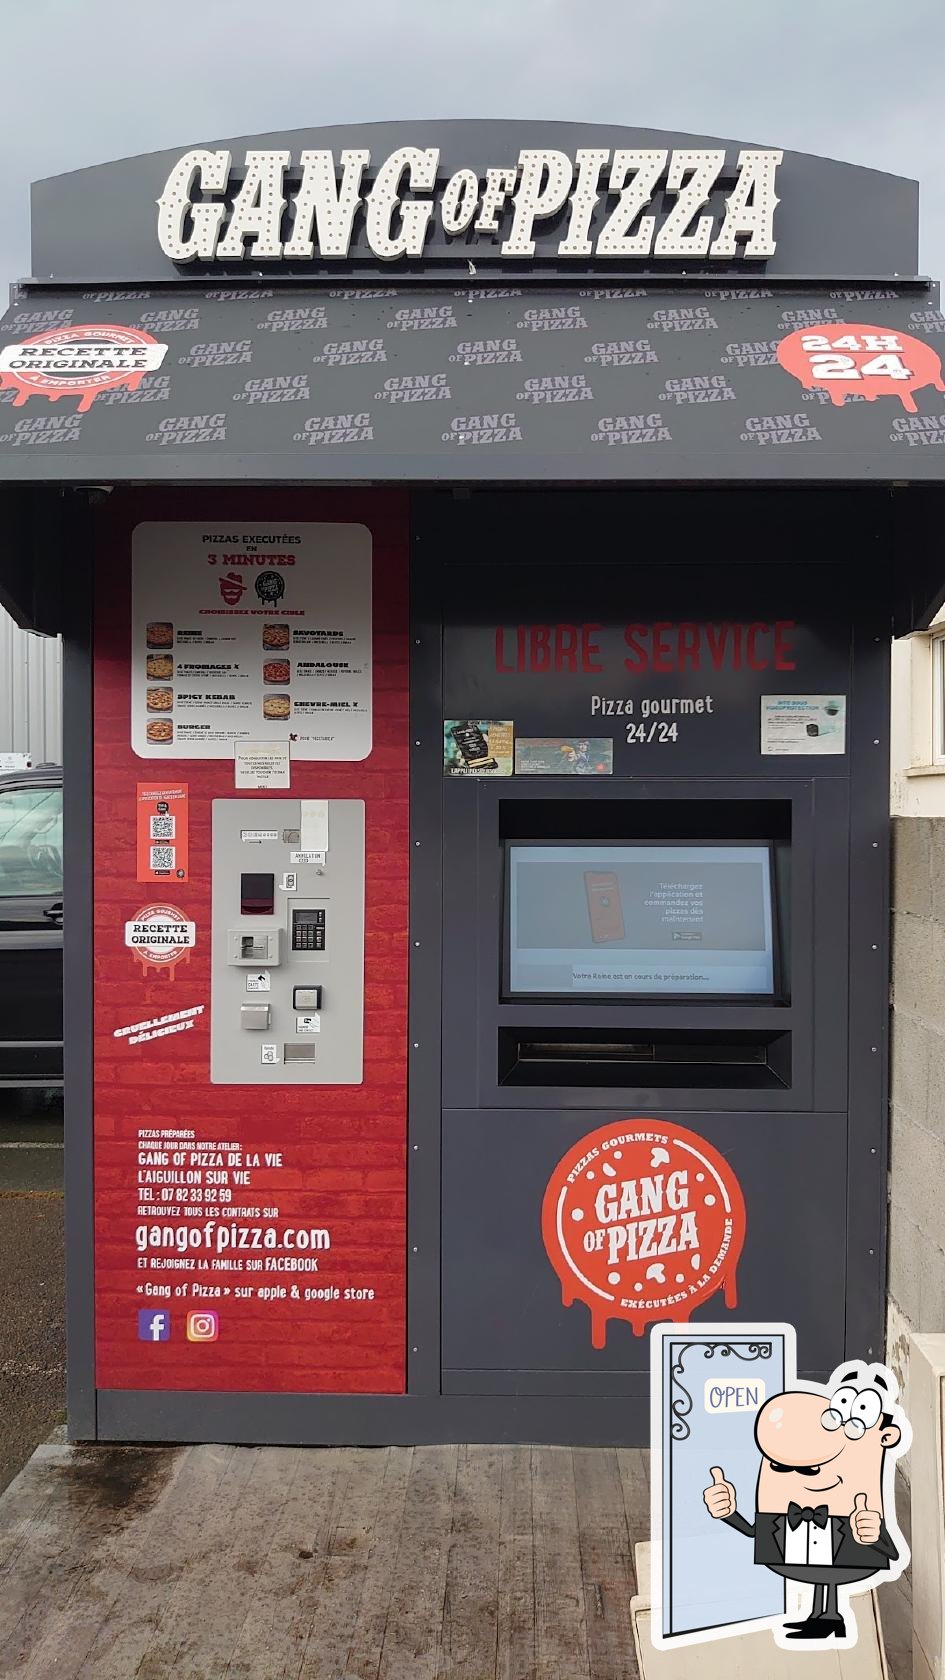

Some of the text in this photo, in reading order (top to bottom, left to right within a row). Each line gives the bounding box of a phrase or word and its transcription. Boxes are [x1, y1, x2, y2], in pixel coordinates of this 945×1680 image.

[155, 147, 784, 260] GANG OF PIZZA
[267, 307, 326, 322] GANG
[395, 306, 453, 321] GANG
[524, 306, 581, 321] GANG
[257, 317, 329, 333] OF PIZZA
[386, 317, 458, 332] OF PIZZA
[516, 317, 589, 332] OF PIZZA
[19, 347, 148, 357] RECETTE
[190, 340, 252, 355] GANG
[457, 339, 517, 355] GANG
[592, 340, 651, 355] GANG
[801, 335, 904, 352] 24H
[9, 359, 148, 369] ORIGINALE
[178, 350, 253, 368] OF PIZZA
[448, 350, 524, 366] OF PIZZA
[583, 351, 660, 367] OF PIZZA
[808, 353, 915, 381] 24
[42, 375, 111, 387] EMPORTER
[245, 375, 309, 392] GANG
[524, 375, 587, 392] GANG
[665, 375, 727, 392] GANG
[233, 387, 311, 405] OF PIZZA
[516, 387, 595, 405] OF PIZZA
[657, 388, 737, 405] OF PIZZA
[15, 414, 83, 433] GANG
[159, 414, 227, 433] GANG
[304, 413, 371, 432] GANG
[598, 414, 663, 433] GANG
[745, 414, 811, 432] GANG
[12, 427, 82, 447] PIZZA
[146, 427, 227, 446] OF PIZZA
[293, 427, 374, 446] OF PIZZA
[591, 427, 673, 446] OF PIZZA
[740, 427, 823, 446] OF PIZZA
[202, 534, 302, 544] PIZZAS EXECUTÉES
[207, 554, 296, 566] 3 MINUTES
[494, 620, 796, 674] LIBRE SERVICE
[591, 696, 714, 717] Pizza gourmet
[624, 722, 679, 744] 24/24
[659, 882, 704, 892] Téléchargez
[644, 899, 688, 907] commandez
[133, 924, 188, 933] RECETTE
[131, 935, 190, 944] ORIGINALE
[573, 972, 592, 981] Votre
[113, 1005, 205, 1038] CRUELLEMENT
[128, 1019, 195, 1045] DÉLICIEUX
[138, 1128, 195, 1139] PIZZAS PRÉPARÉES
[138, 1141, 163, 1150] CHAQUE
[163, 1141, 178, 1150] JOUR
[179, 1141, 196, 1150] DANS
[197, 1142, 217, 1150] NOTRE
[138, 1151, 283, 1167] GANG OF PIZZA DE LA VIE
[567, 1132, 669, 1184] PIZZAS GOURMETS
[137, 1169, 251, 1185] L'AIGUILLON SUR VIE
[161, 1188, 174, 1202] 07
[175, 1188, 189, 1202] 82
[190, 1188, 203, 1202] 33
[204, 1188, 217, 1202] 92
[219, 1188, 232, 1203] 59
[594, 1170, 689, 1224] GANG
[137, 1205, 279, 1218] RETROUVEZ TOUS LES CONTRATS SUR
[135, 1220, 331, 1253] gangofpizza.com
[583, 1211, 700, 1265] OF PIZZA
[137, 1257, 319, 1272] ET REJOIGNEZ LA FAMILLE SUR FACEBOOK
[620, 1218, 733, 1309] EXÉCUTÉES À LA DEMANDE
[175, 1283, 188, 1297] of
[234, 1287, 254, 1298] sur
[257, 1285, 287, 1300] apple
[290, 1284, 300, 1299] &
[304, 1285, 340, 1301] google
[343, 1287, 375, 1300] store
